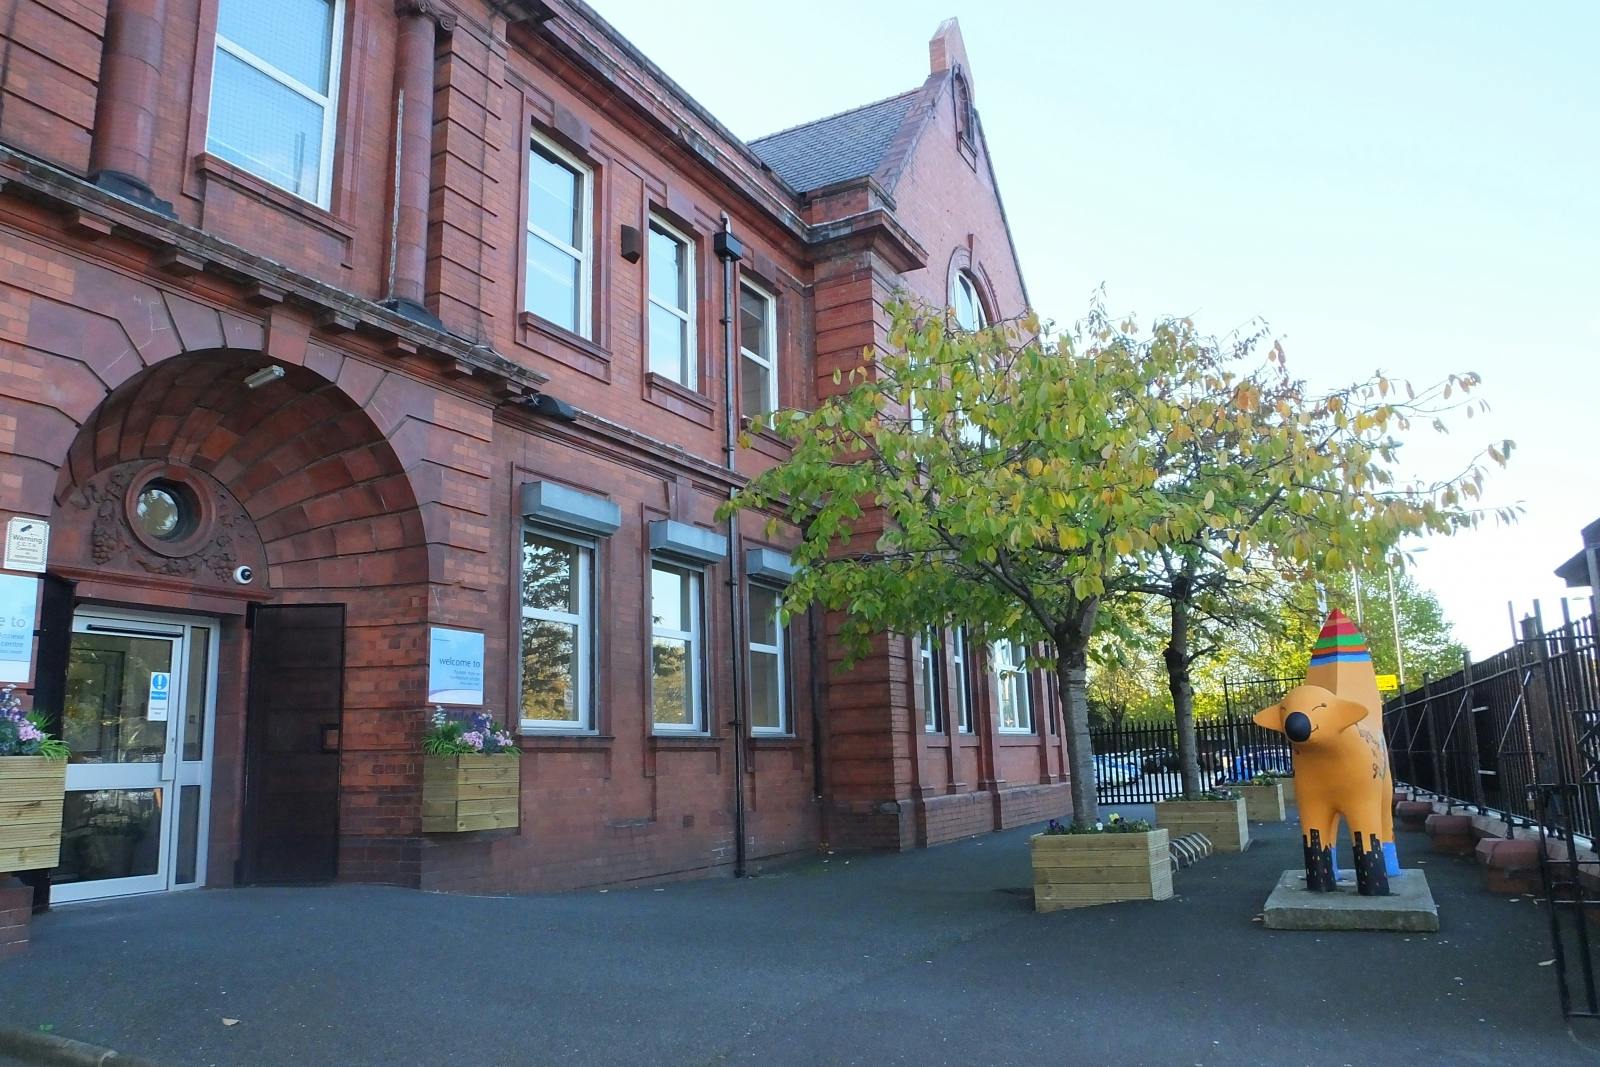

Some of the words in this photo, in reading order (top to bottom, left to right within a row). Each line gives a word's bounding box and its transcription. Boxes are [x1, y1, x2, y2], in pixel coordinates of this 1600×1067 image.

[13, 534, 43, 544] Warning
[11, 616, 26, 627] to
[440, 657, 471, 667] welcome
[473, 659, 480, 668] to
